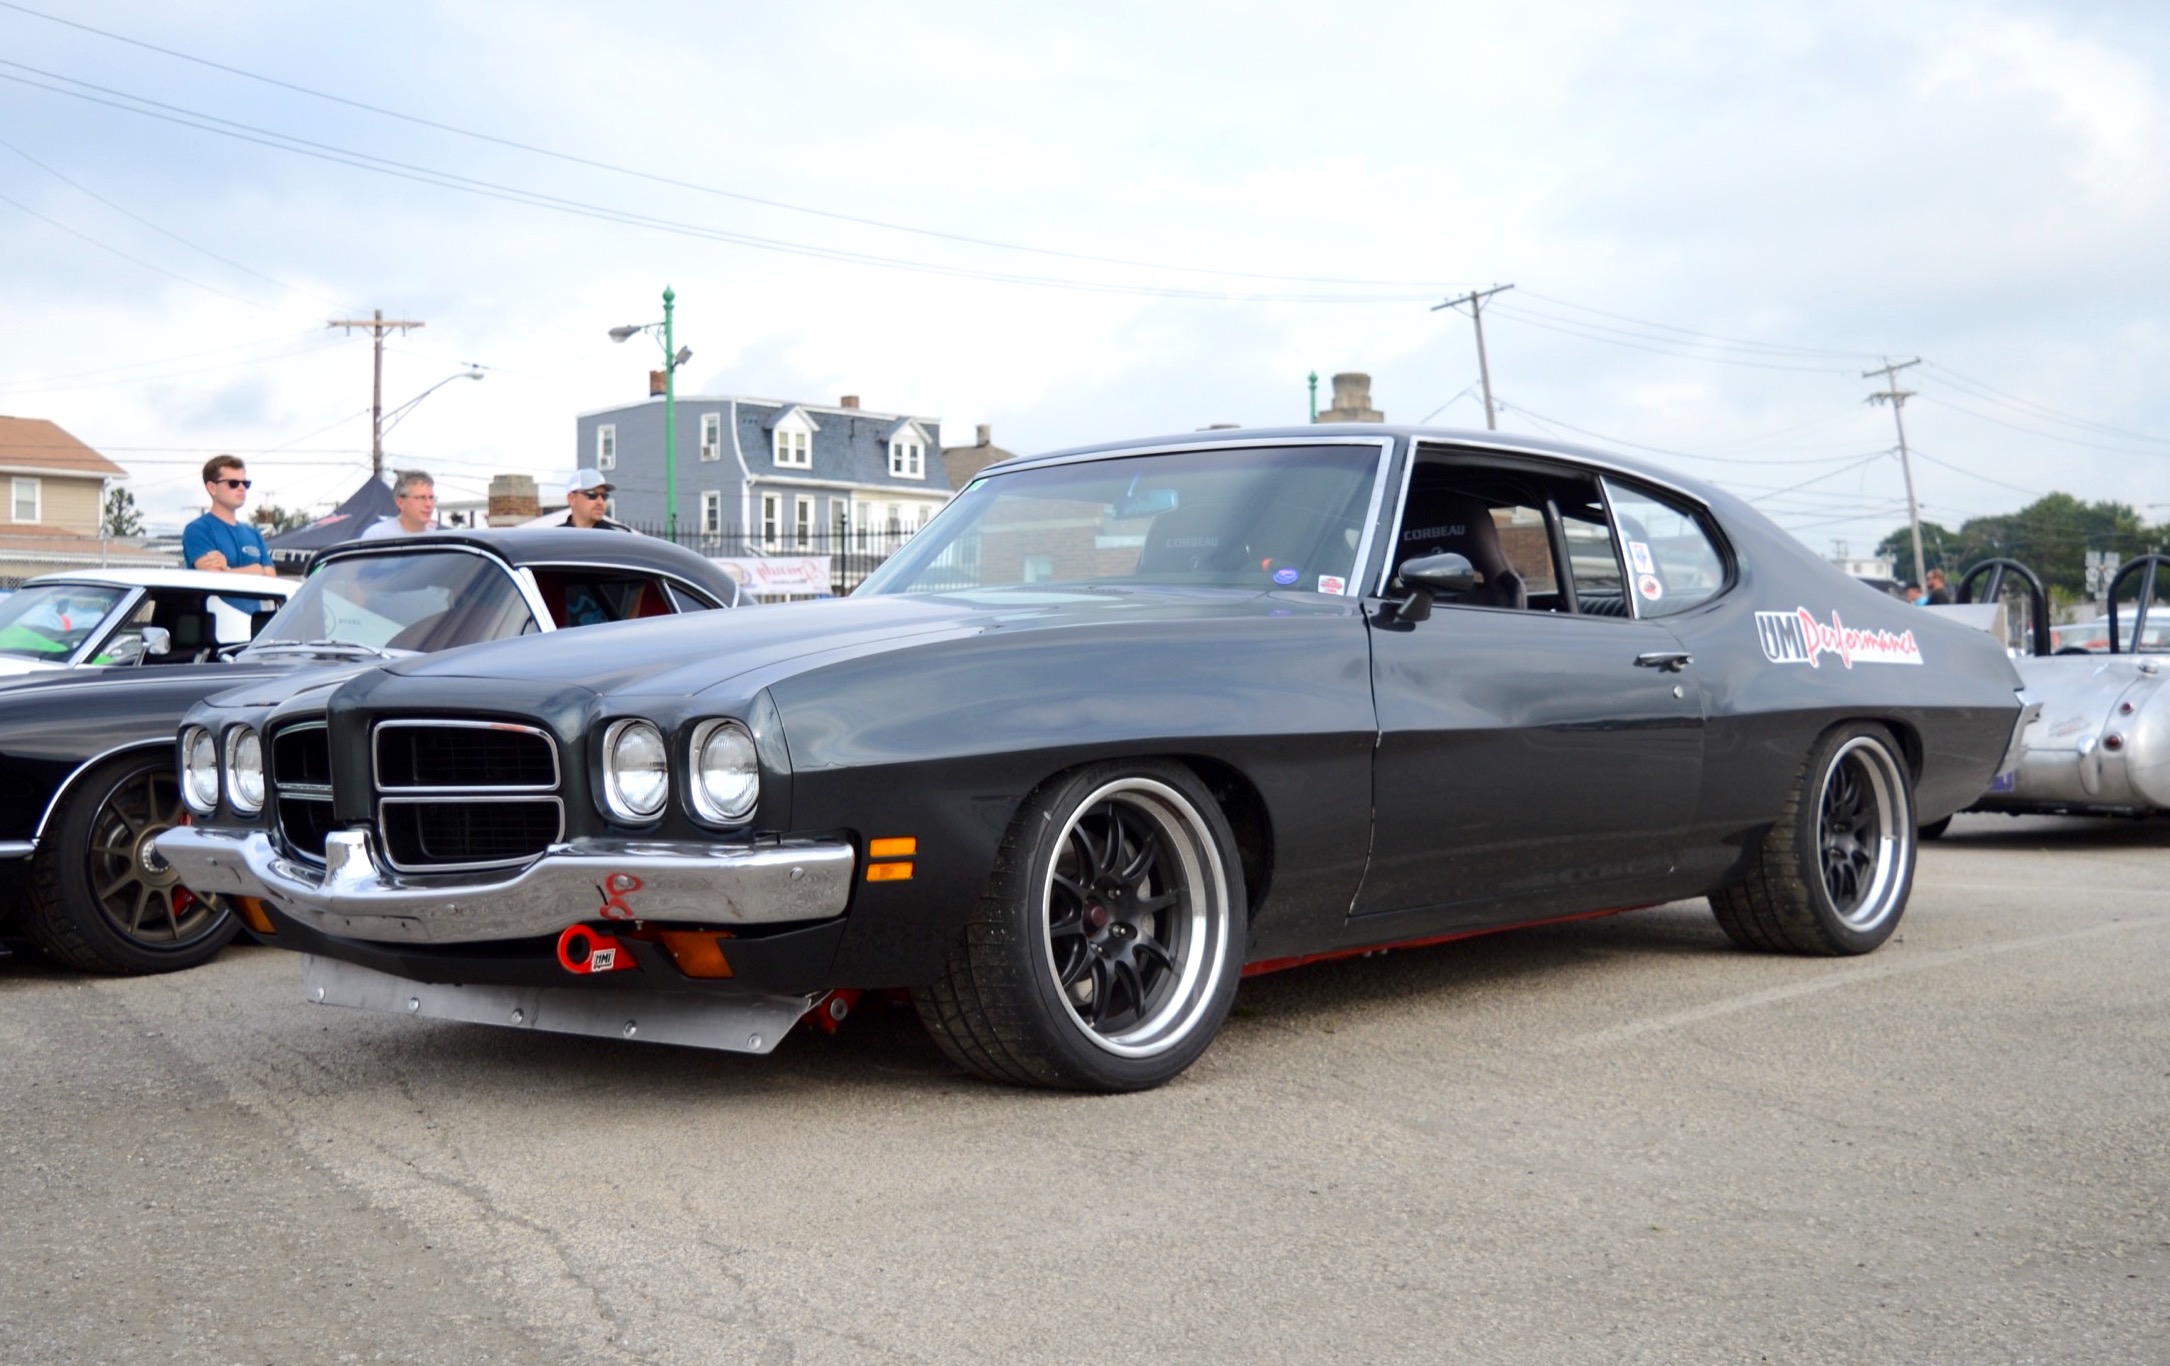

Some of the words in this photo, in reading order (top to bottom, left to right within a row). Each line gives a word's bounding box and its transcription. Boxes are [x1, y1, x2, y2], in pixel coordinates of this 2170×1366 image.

[1403, 524, 1466, 542] CORBEAU
[1165, 536, 1219, 549] CORBEAU
[1757, 614, 1808, 660] UMI
[594, 951, 613, 967] UMI
